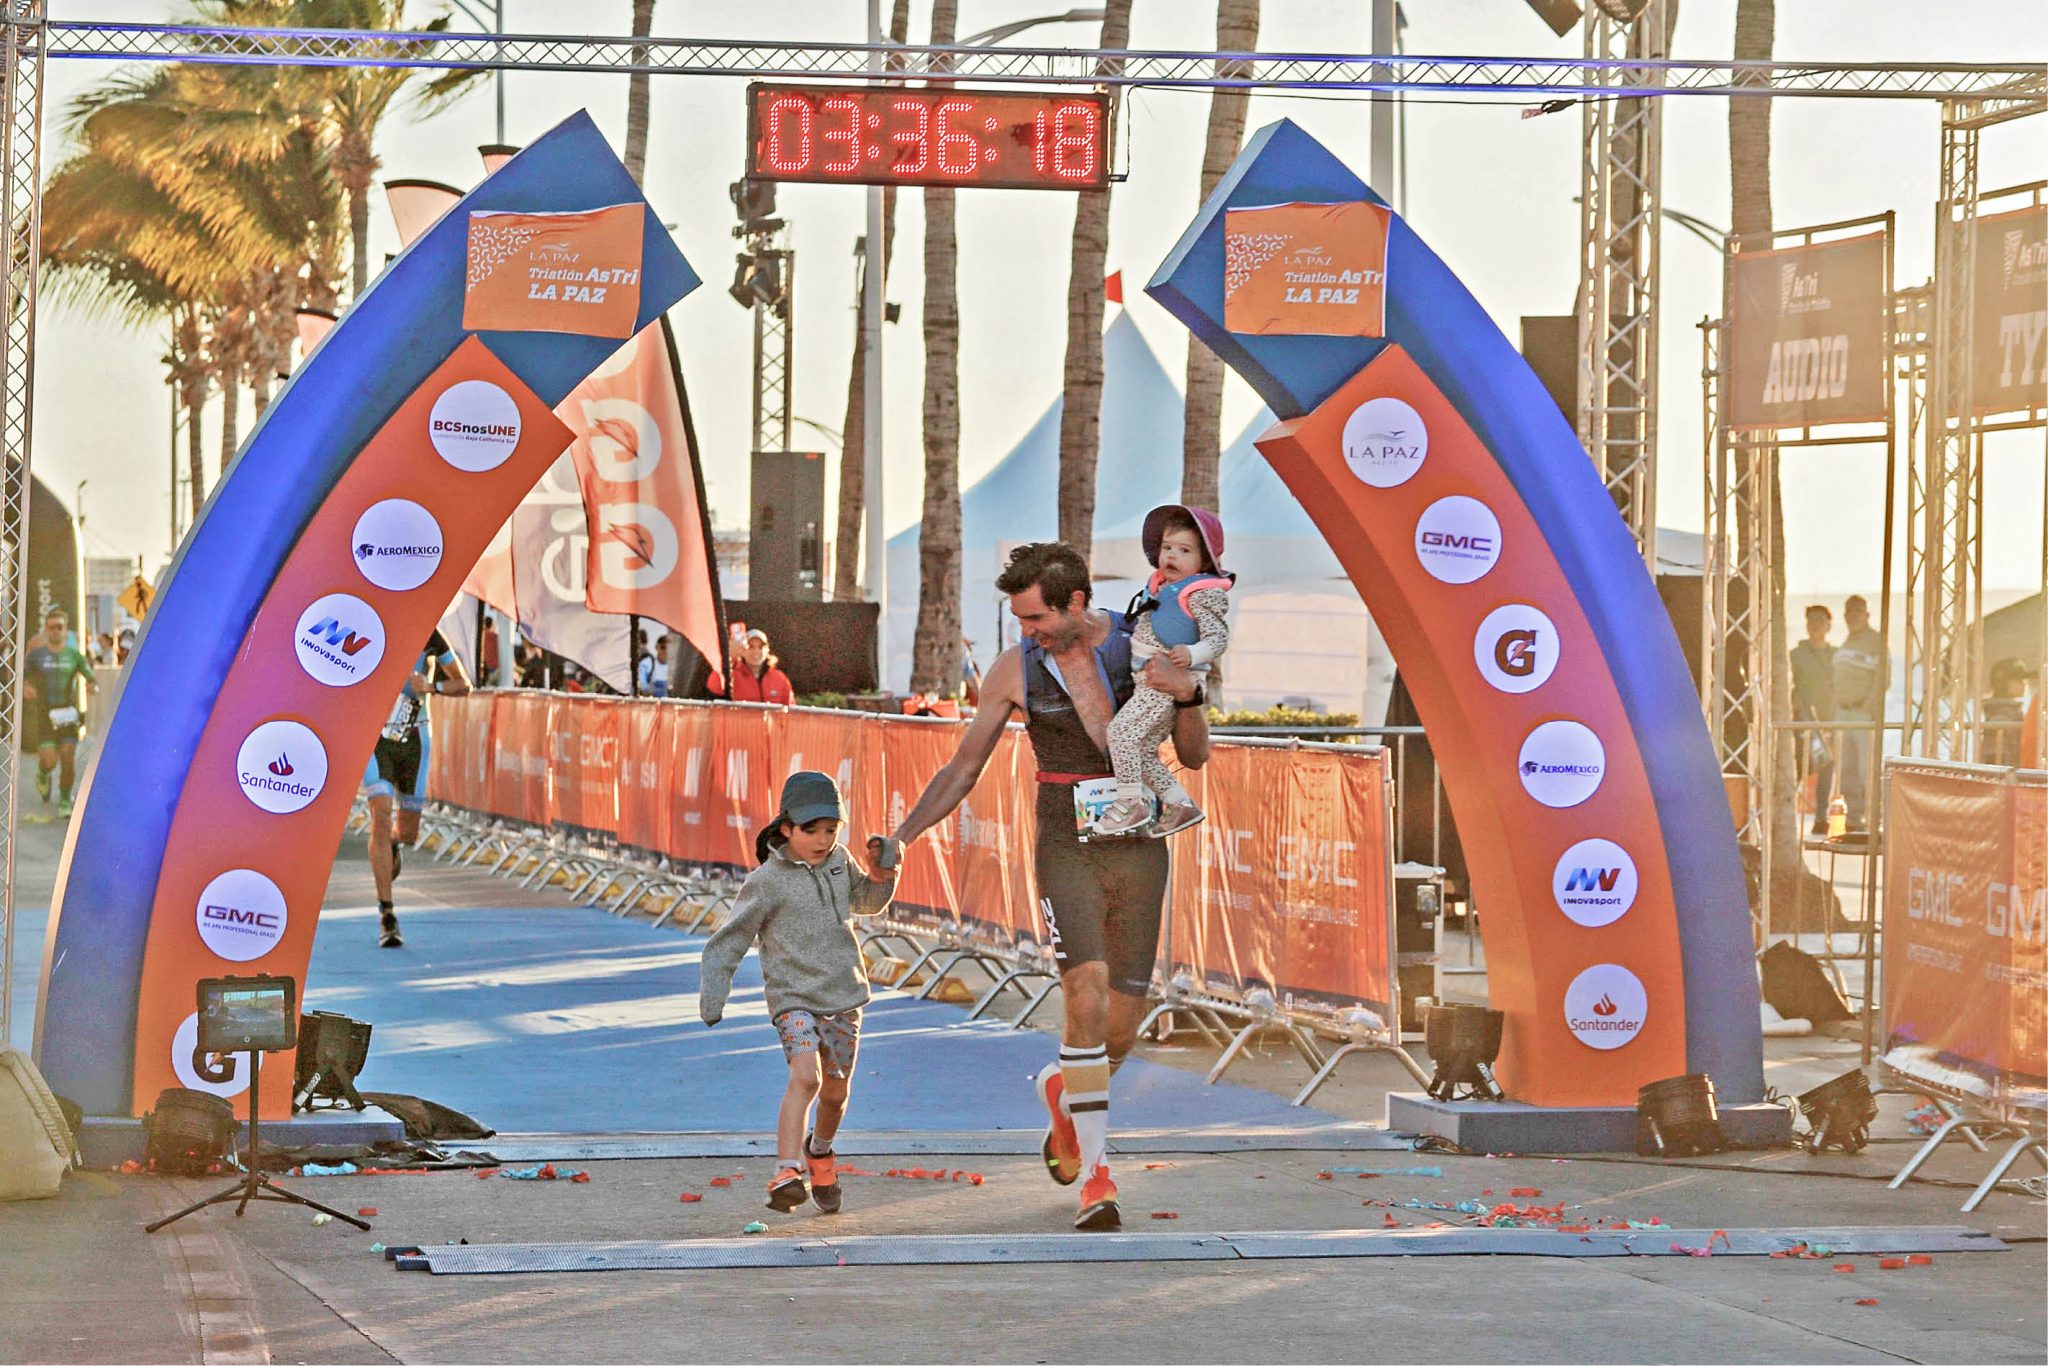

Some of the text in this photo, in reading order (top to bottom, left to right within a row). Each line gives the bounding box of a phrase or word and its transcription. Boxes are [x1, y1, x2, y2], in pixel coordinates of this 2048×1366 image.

[769, 98, 1095, 178] 03:36:18
[529, 251, 580, 264] LA PAZ
[1283, 256, 1334, 267] LA PAZ
[529, 267, 638, 286] Triatlón AsTri
[1284, 271, 1337, 284] Triatlón
[528, 284, 606, 303] LA PAZ
[1284, 287, 1361, 305] LA PAZ
[2000, 310, 2048, 388] TY
[1762, 334, 1849, 405] AUDIO
[434, 421, 516, 437] BCSnosUNE
[1349, 446, 1420, 459] LA PAZ
[1421, 532, 1492, 552] GMC
[1494, 629, 1539, 677] G
[241, 772, 315, 797] Santander
[1194, 827, 1359, 888] GMC GMC
[1907, 867, 1964, 928] GMC
[204, 905, 279, 929] GMC
[1570, 1018, 1639, 1032] Santander
